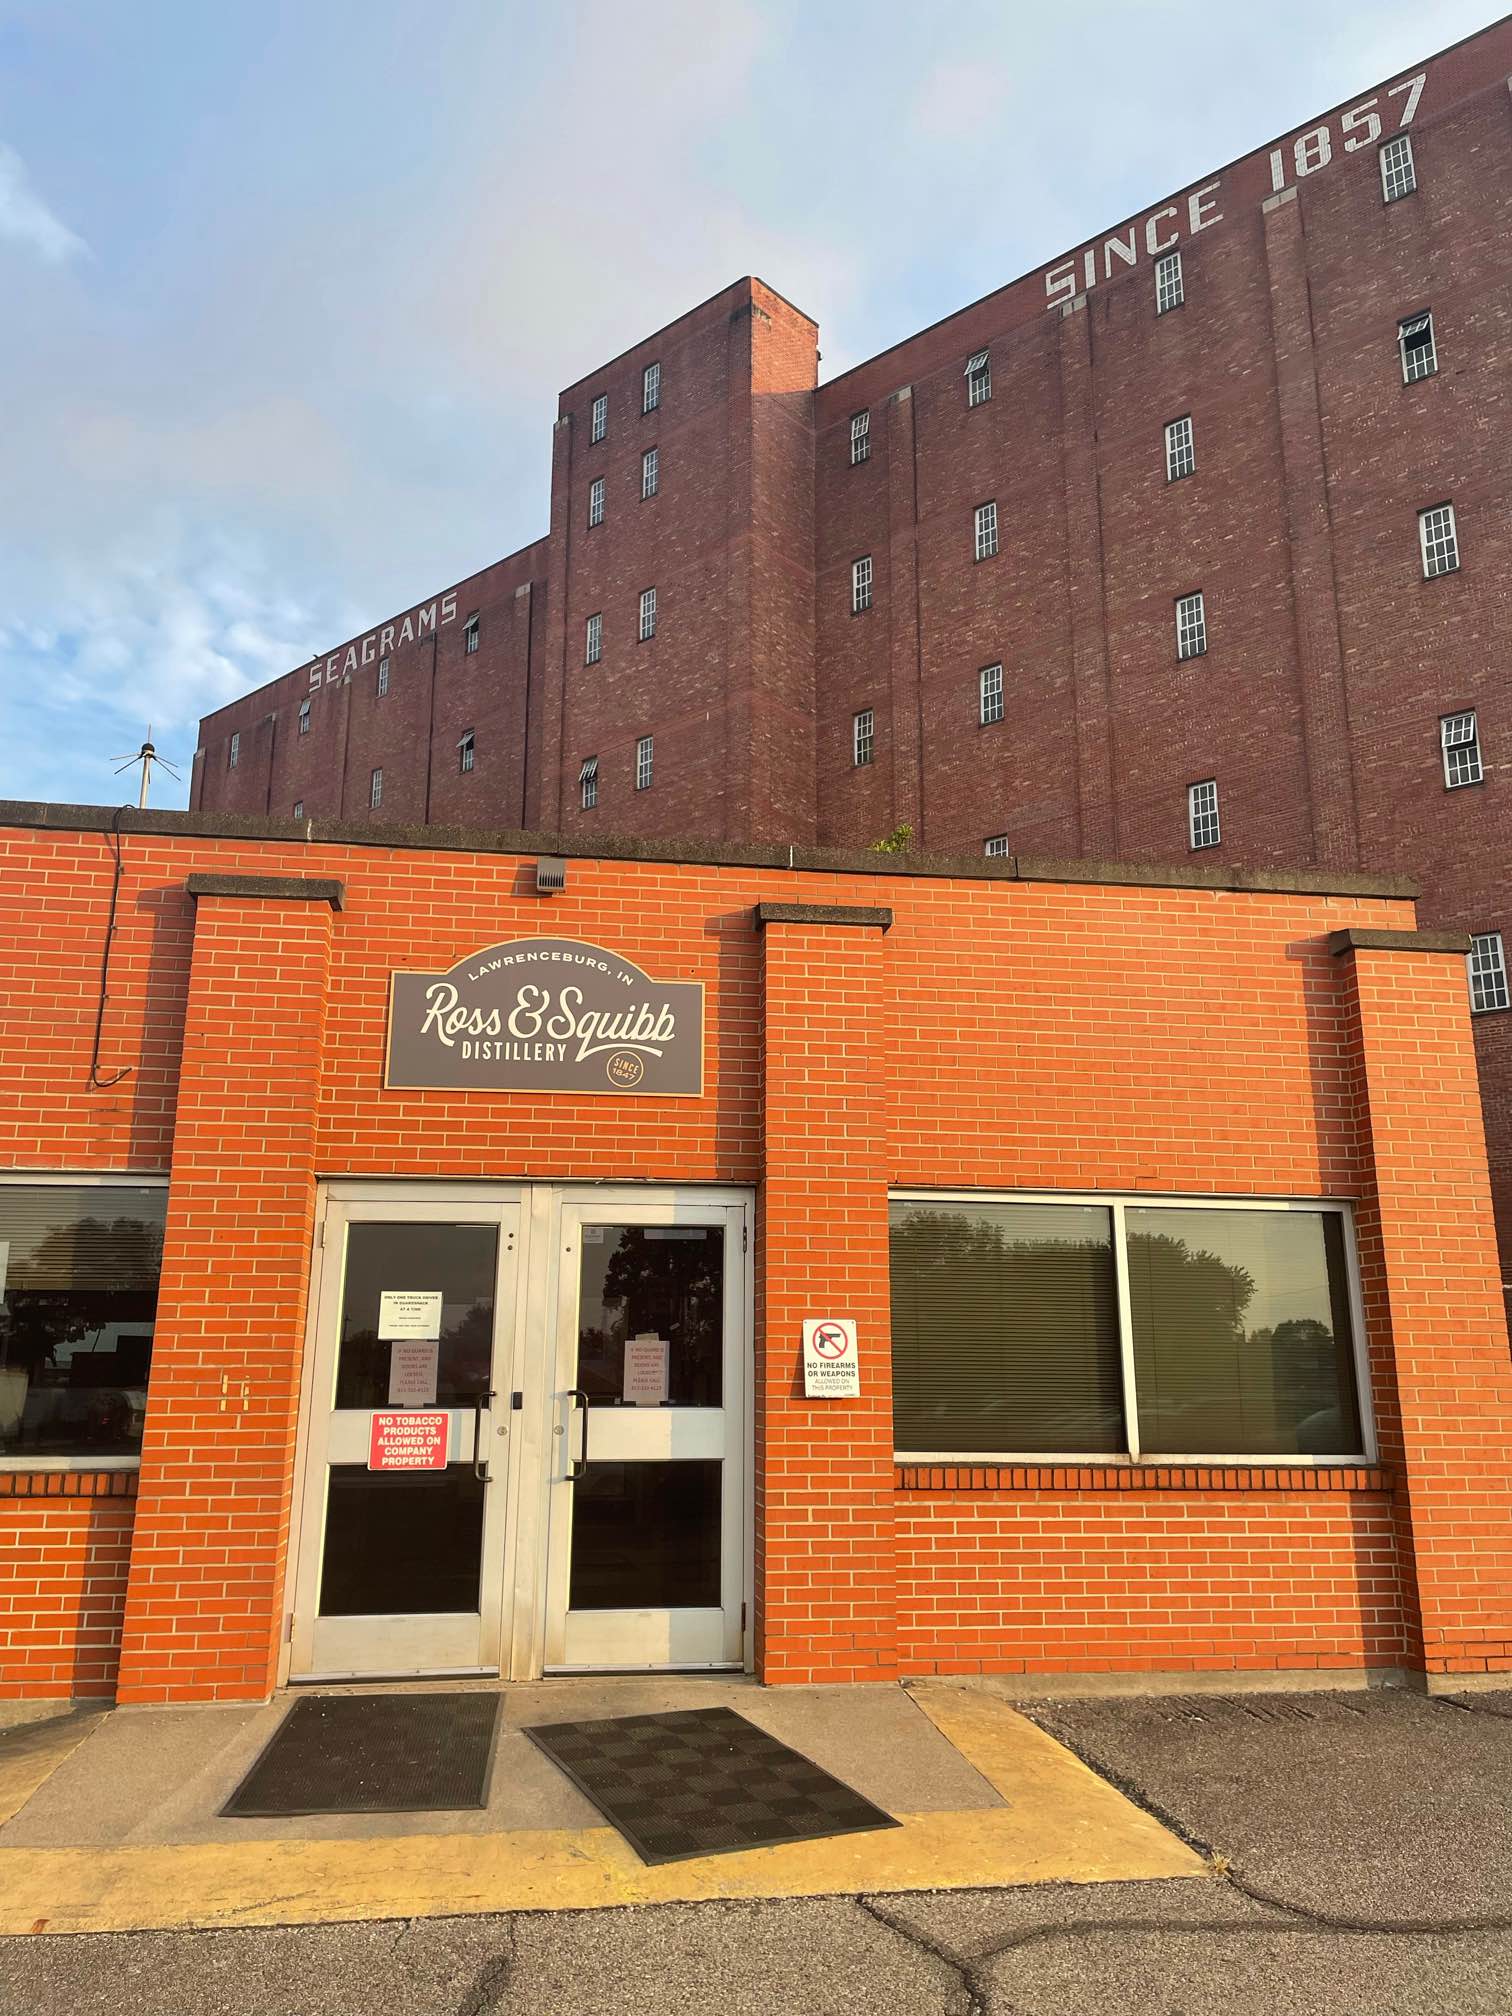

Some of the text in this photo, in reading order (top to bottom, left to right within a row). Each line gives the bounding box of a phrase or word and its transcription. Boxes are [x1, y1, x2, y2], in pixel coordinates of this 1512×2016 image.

[1045, 72, 1427, 310] SINCE 1857
[309, 592, 457, 693] SEAGRAMS
[467, 951, 634, 987] LAWRENCEBURG, IN
[420, 982, 676, 1062] Ross & Squibb
[462, 1041, 567, 1062] DISTILLERY
[614, 1057, 640, 1074] SINCE
[612, 1067, 636, 1080] 1847
[379, 1417, 442, 1425] NO TOBACCO
[383, 1427, 437, 1435] PRODUCTS
[377, 1436, 441, 1446] ALLOWED ON
[384, 1446, 433, 1455] COMPANY
[381, 1456, 435, 1465] PROPERTY
